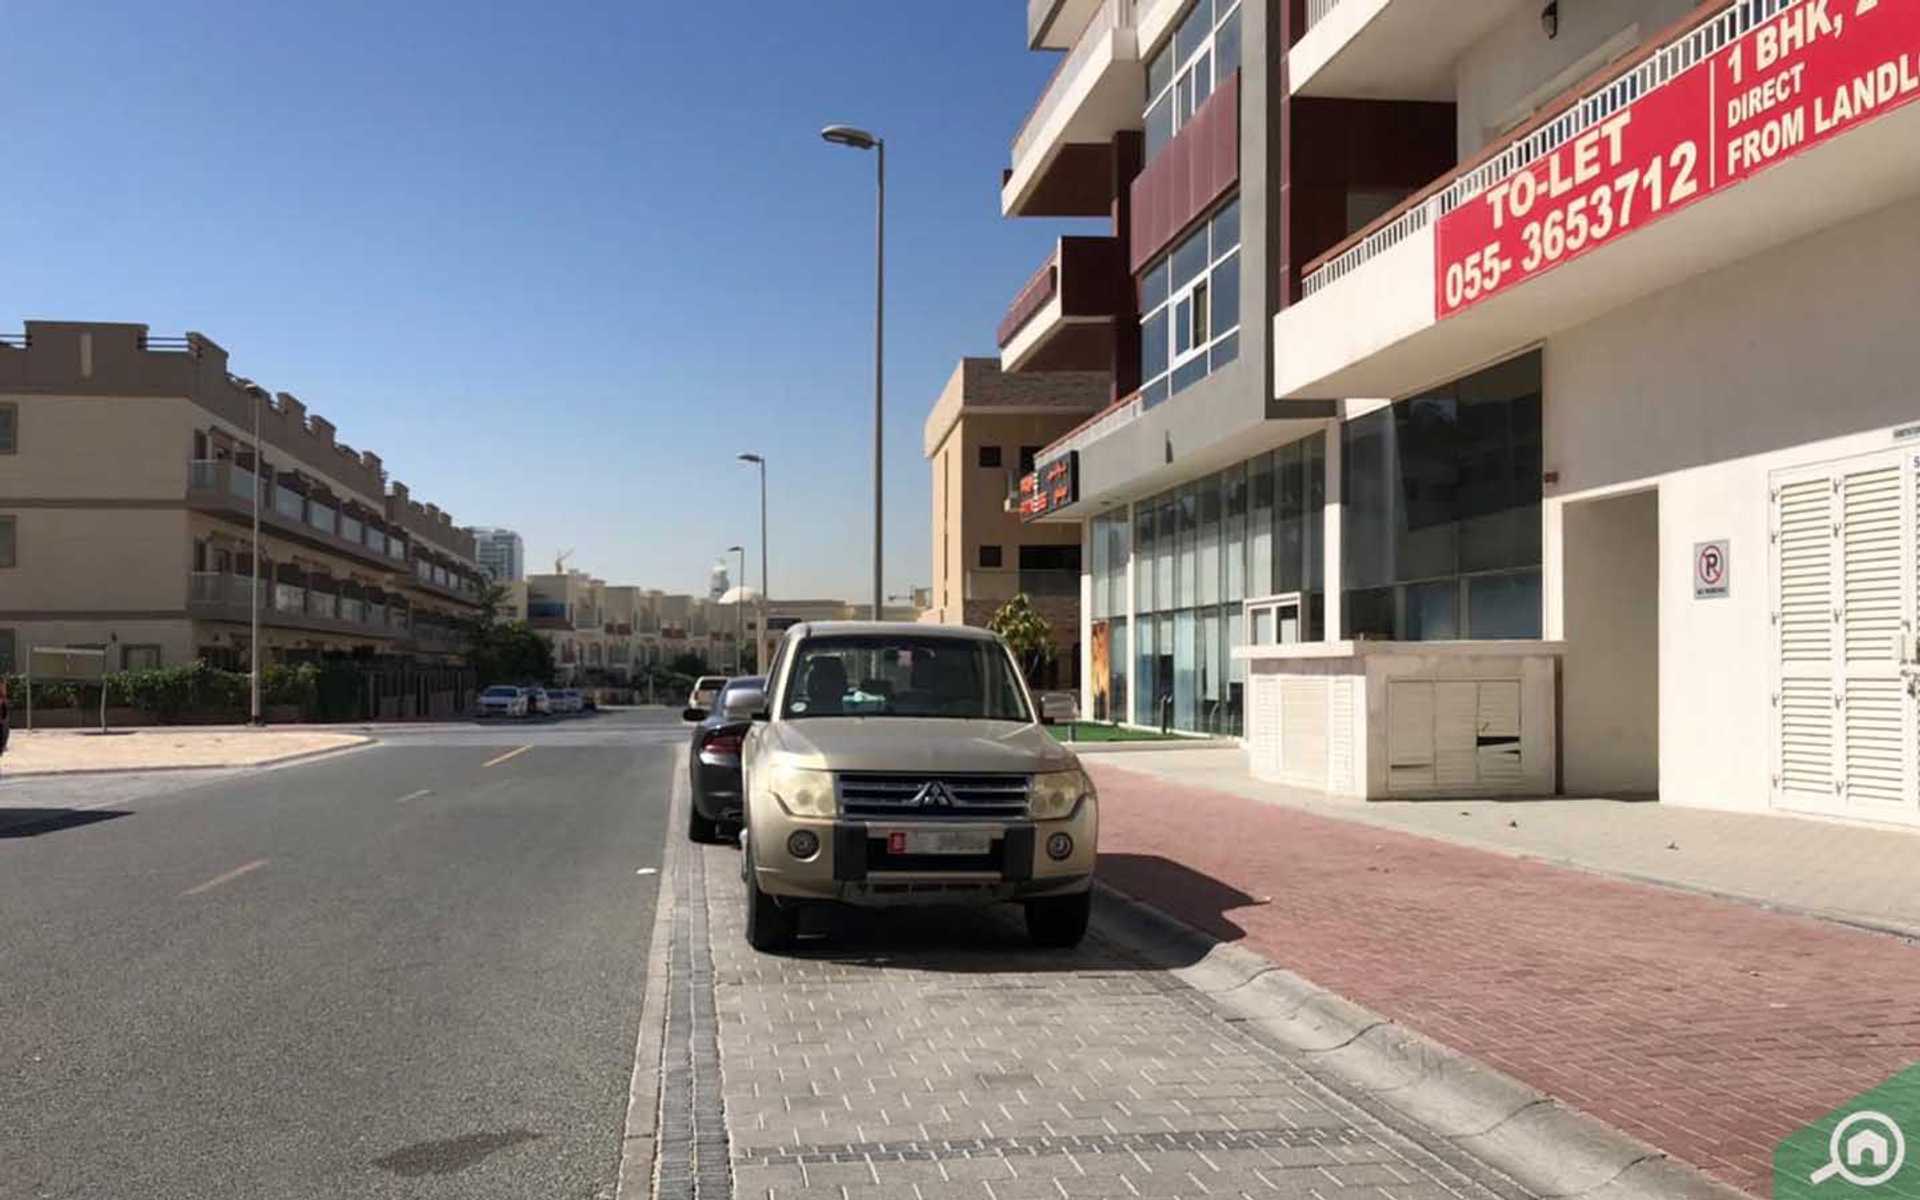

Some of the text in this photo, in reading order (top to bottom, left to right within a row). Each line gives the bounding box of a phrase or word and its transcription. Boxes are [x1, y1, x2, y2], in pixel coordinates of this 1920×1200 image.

[1728, 0, 1843, 85] 1 BHK,
[1728, 62, 1805, 127] DIRECT
[1487, 112, 1632, 229] TO-LET
[1728, 53, 1920, 175] FROM LANDL
[1446, 141, 1698, 308] 055- 3653712
